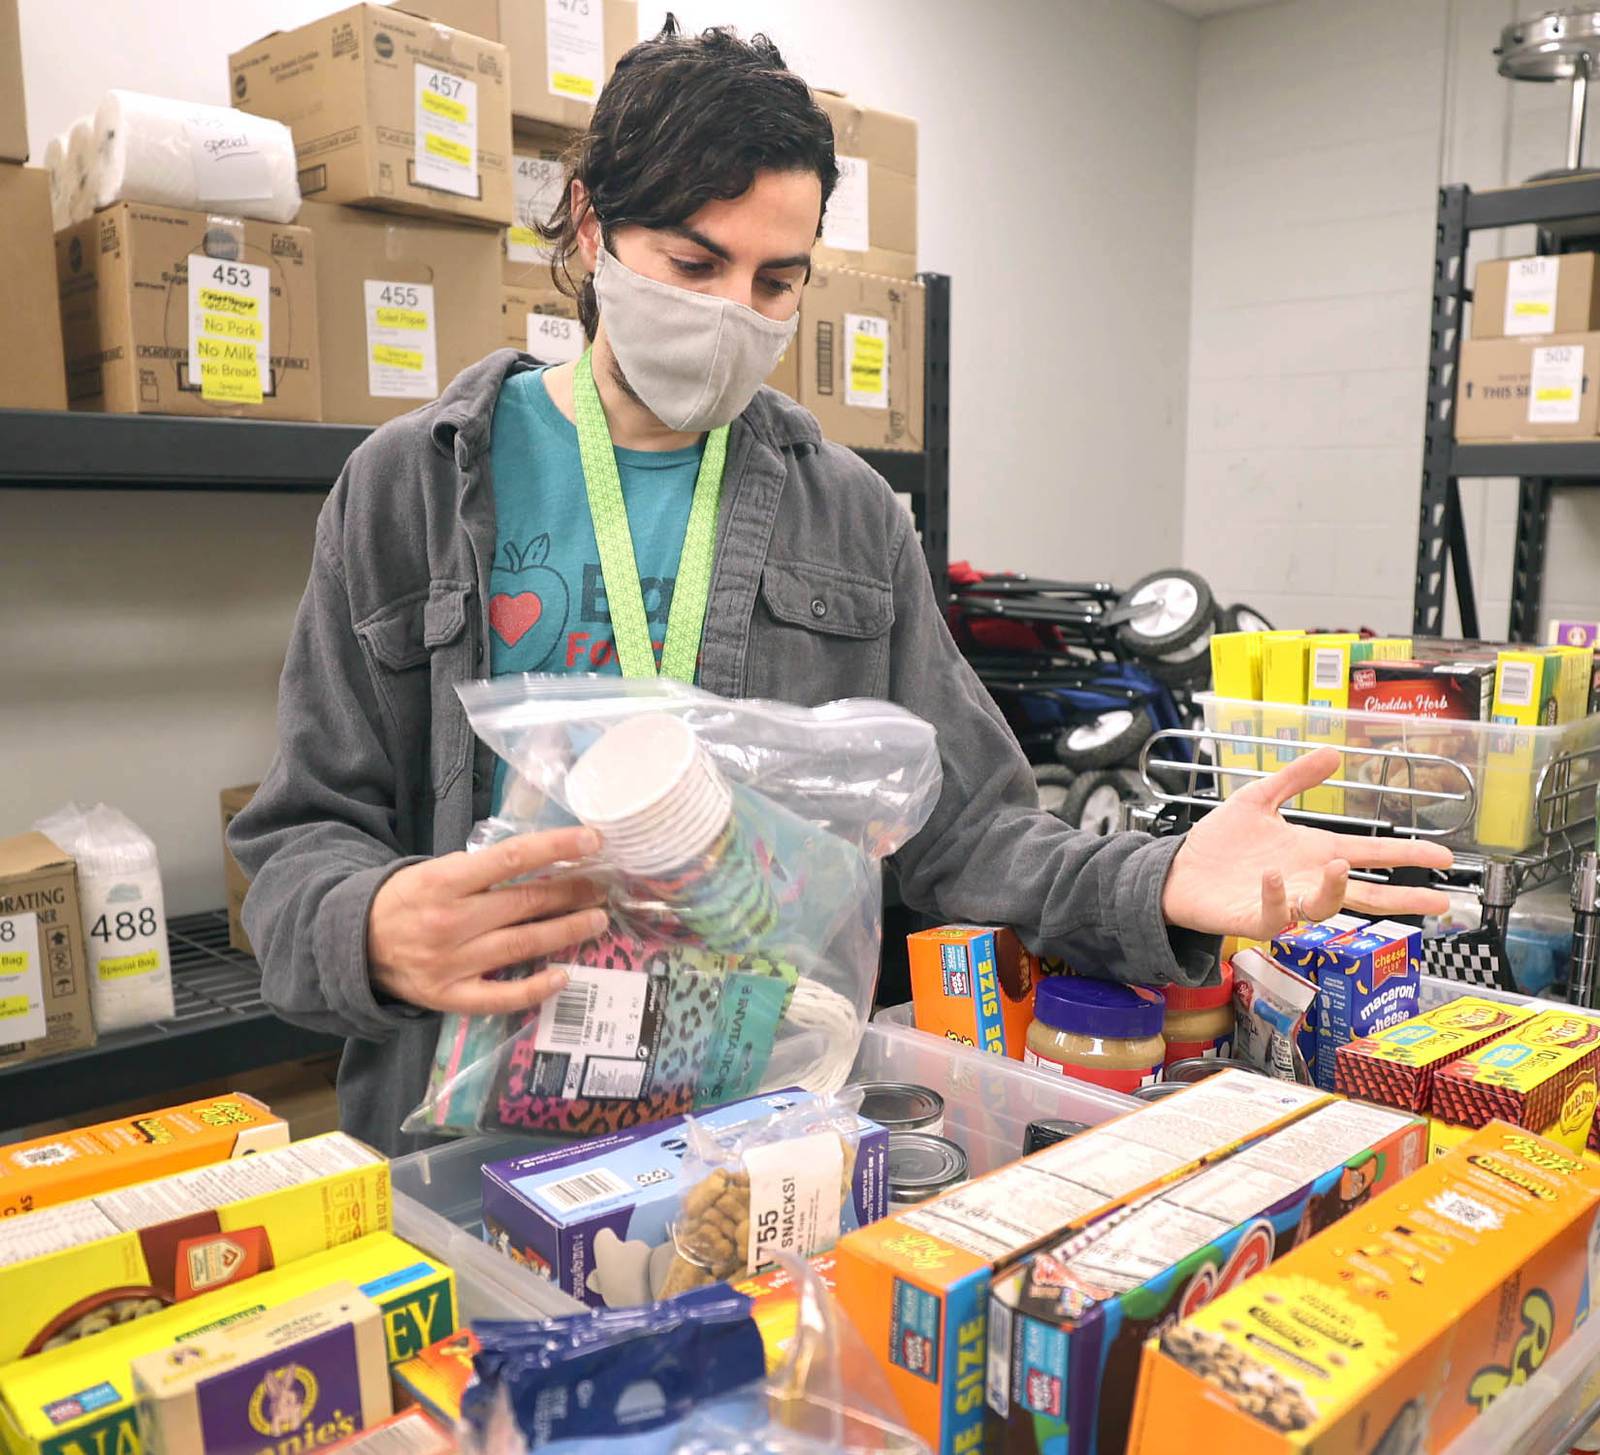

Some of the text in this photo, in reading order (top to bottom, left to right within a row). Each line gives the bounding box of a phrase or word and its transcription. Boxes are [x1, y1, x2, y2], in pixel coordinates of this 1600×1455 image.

[428, 73, 462, 99] 457
[517, 159, 552, 180] 468
[212, 264, 251, 288] 453
[379, 286, 419, 307] 455
[204, 318, 256, 337] No Pork
[539, 320, 571, 341] 463
[857, 320, 879, 335] 471
[198, 341, 256, 361] No Milk
[201, 362, 218, 376] No
[221, 364, 257, 378] Bread
[1483, 386, 1513, 399] THIS
[1364, 694, 1448, 713] Cheddar Herb
[90, 907, 157, 943] 488
[1, 955, 23, 966] Bag
[99, 958, 156, 977] Special Bag
[1375, 947, 1406, 969] cheese
[978, 959, 999, 1017] SIZE
[1361, 983, 1416, 1020] macaroni
[1383, 1001, 1397, 1014] and
[1368, 1009, 1410, 1035] cheese
[781, 1176, 796, 1249] SNACKS!
[955, 1315, 986, 1416] SIZE
[254, 1409, 355, 1455] nie's
